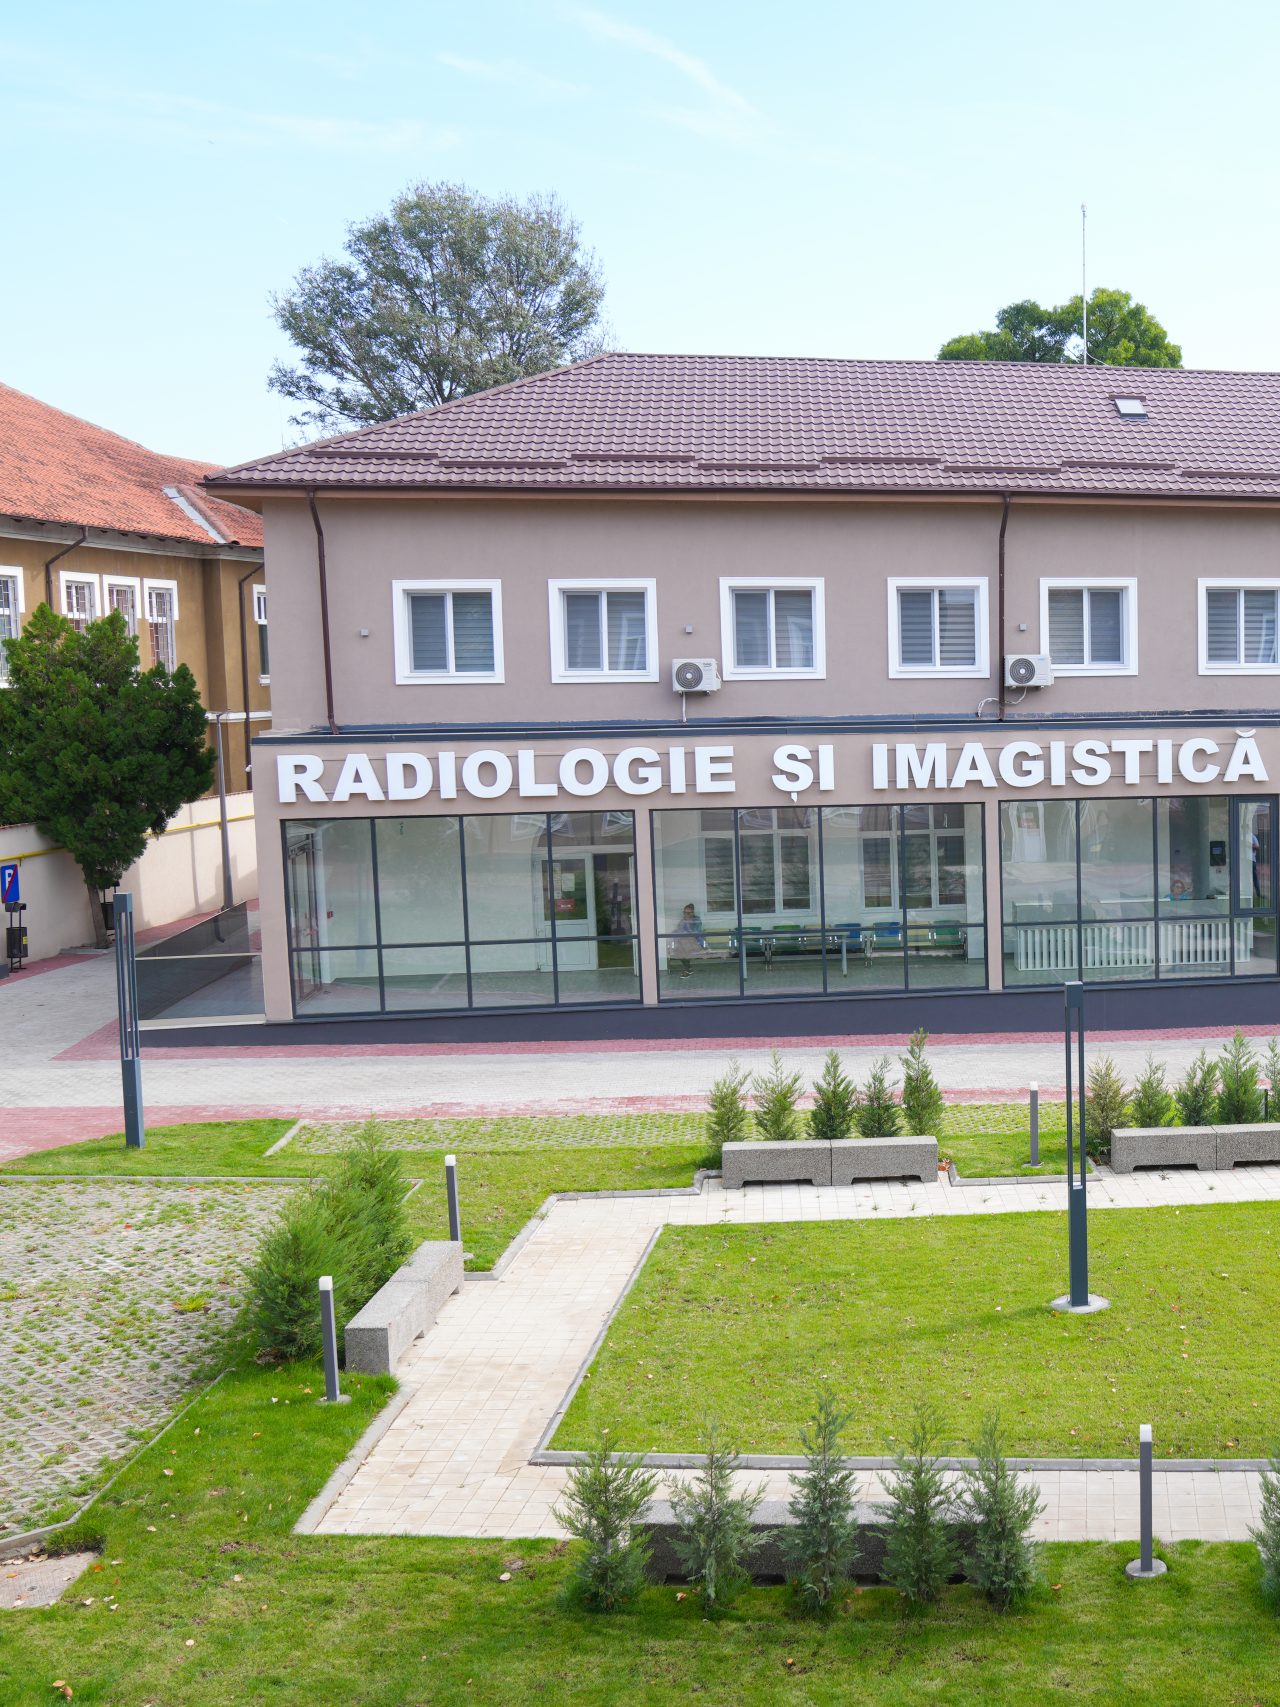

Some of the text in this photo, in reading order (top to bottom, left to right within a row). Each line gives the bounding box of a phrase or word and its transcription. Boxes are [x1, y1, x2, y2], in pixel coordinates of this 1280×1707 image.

[277, 745, 736, 803] RADIOLOGIE
[771, 744, 835, 803] ȘI
[872, 729, 1269, 790] IMAGISTICĂ
